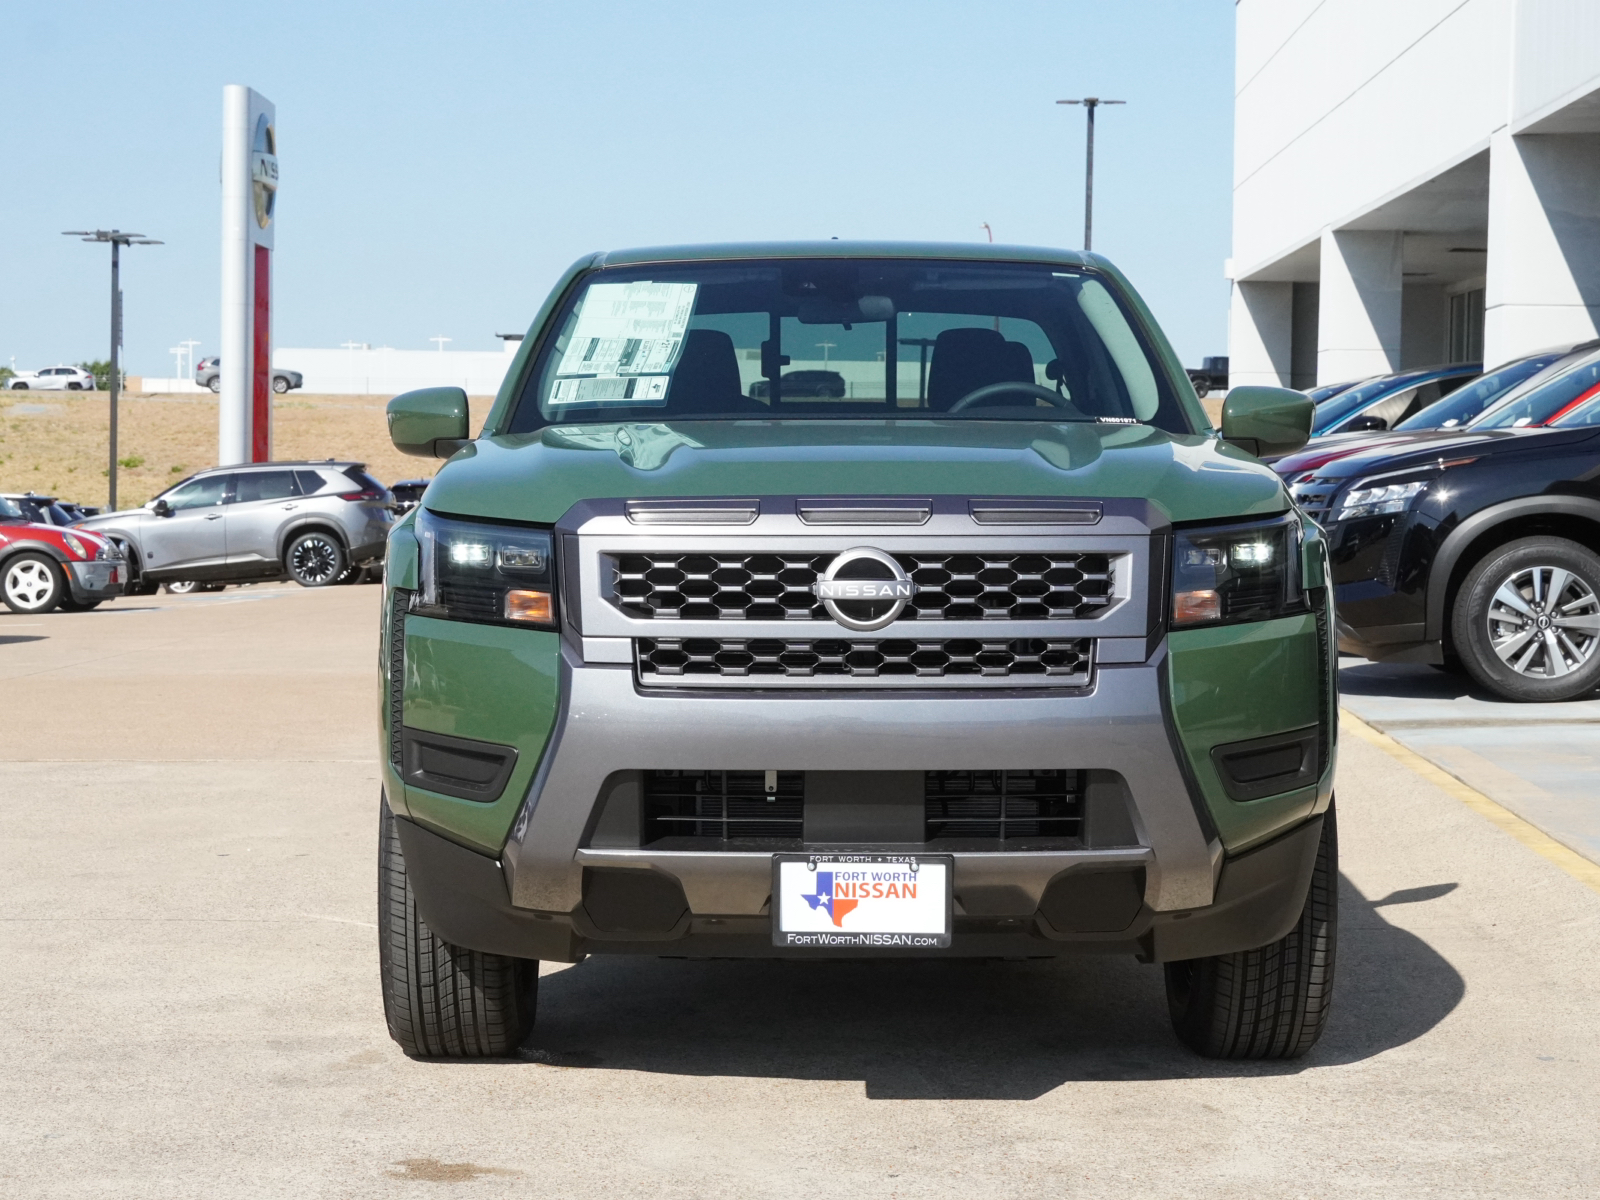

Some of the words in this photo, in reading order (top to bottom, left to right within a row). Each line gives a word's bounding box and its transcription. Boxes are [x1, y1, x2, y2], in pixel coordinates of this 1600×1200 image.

[820, 584, 910, 596] NISSAN
[809, 855, 834, 863] FORT
[838, 855, 872, 863] WORTH
[886, 856, 916, 864] TEXAS
[834, 871, 868, 881] FORT
[871, 871, 917, 882] WORTH
[834, 882, 917, 899] NISSAN
